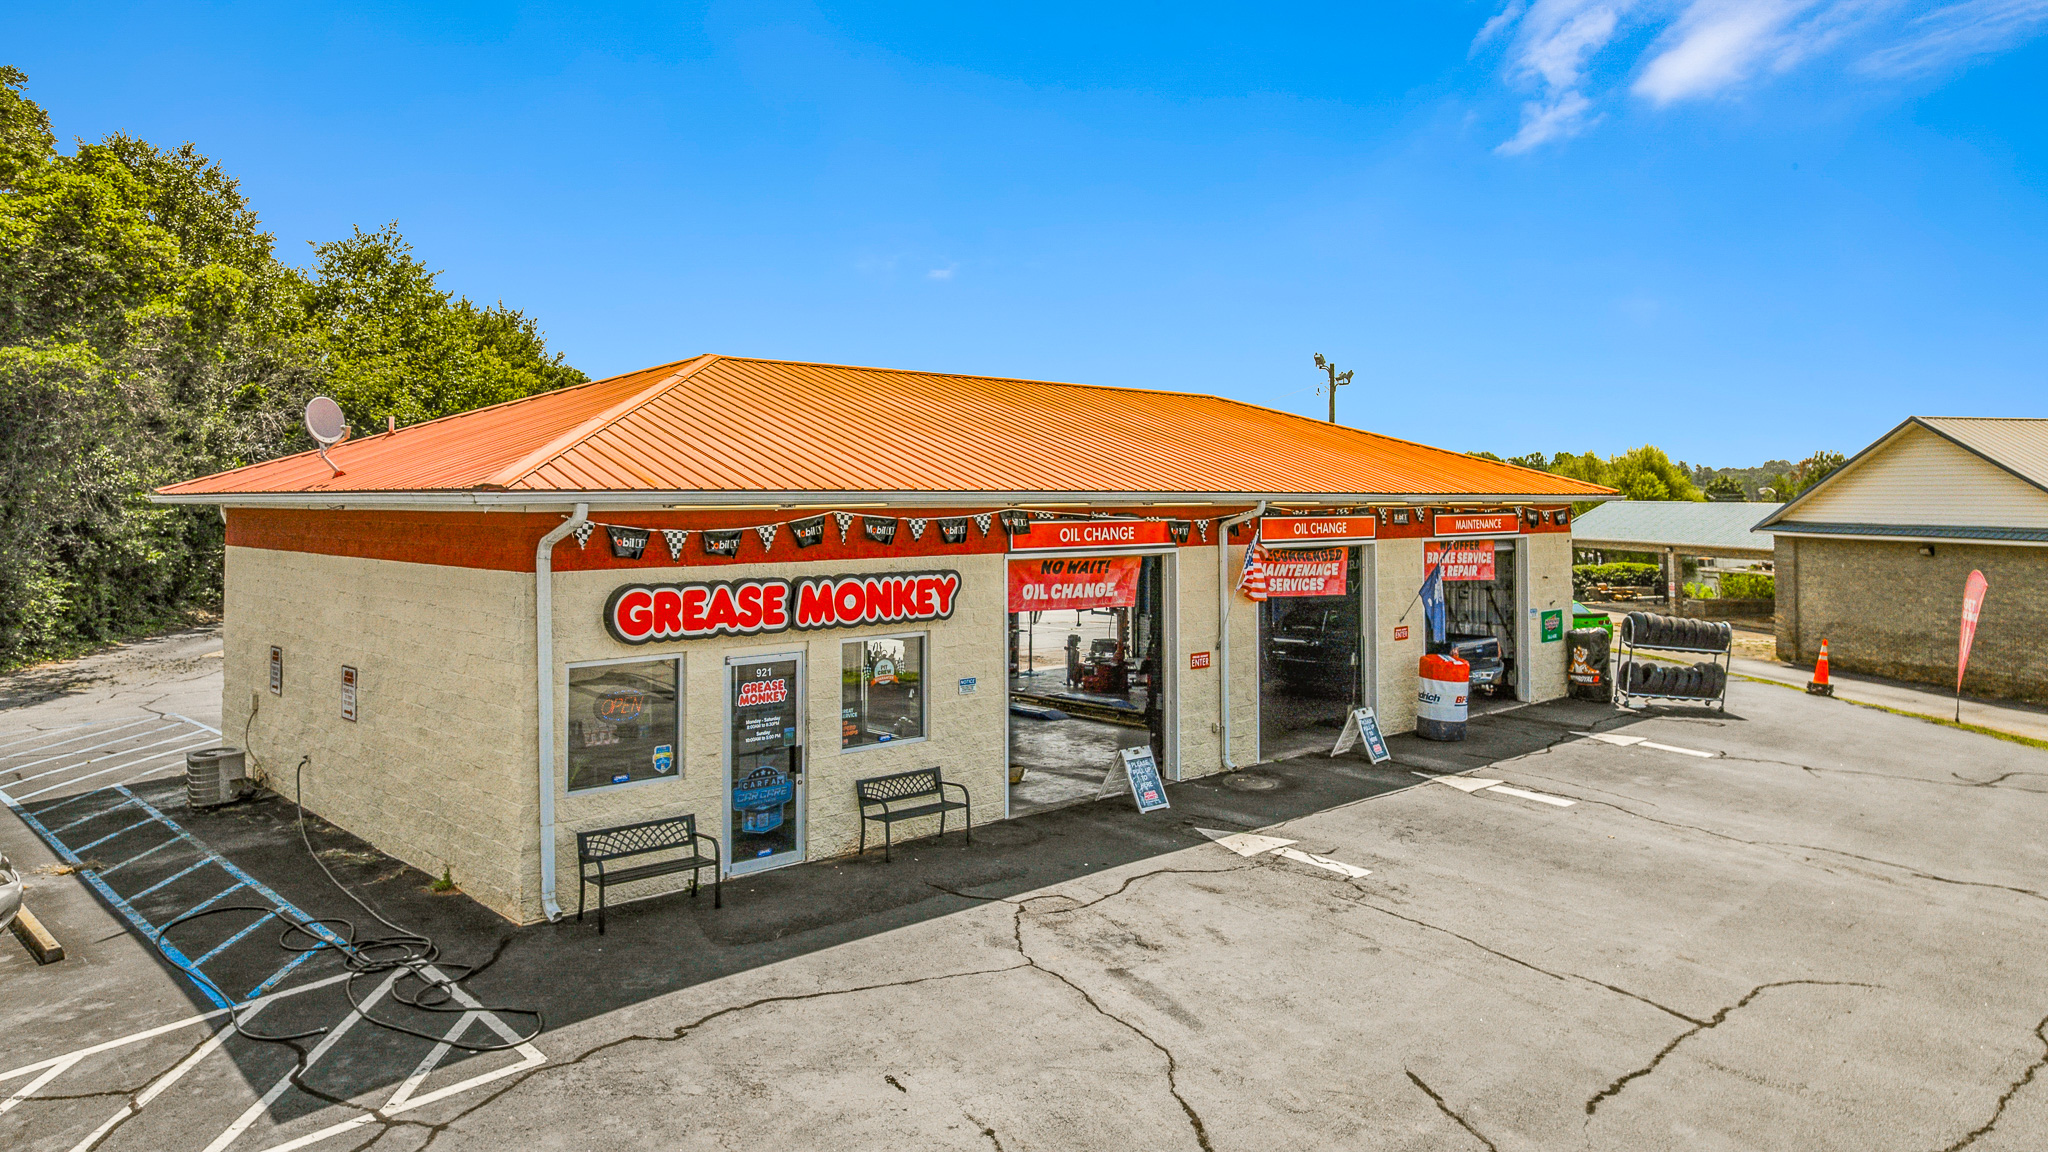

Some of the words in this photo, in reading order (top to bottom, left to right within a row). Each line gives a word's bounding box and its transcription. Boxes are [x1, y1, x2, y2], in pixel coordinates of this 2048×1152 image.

[866, 524, 886, 535] Mobil
[1294, 523, 1308, 534] OIL
[1310, 522, 1347, 534] CHANGE
[1455, 518, 1502, 530] MAINTENANCE
[794, 526, 815, 538] Mobil
[1059, 528, 1080, 542] OIL
[1084, 527, 1134, 541] CHANGE
[1440, 540, 1452, 550] W
[1454, 540, 1479, 550] OFFER
[1265, 549, 1342, 562] ECOMMENDED
[1427, 552, 1456, 564] BRAKE
[1457, 551, 1492, 564] SERVICE
[1041, 560, 1065, 574] NO
[1067, 559, 1112, 574] WAIT!
[1447, 565, 1478, 577] REPAIR
[1022, 583, 1048, 600] OIL
[1051, 582, 1118, 599] CHANGE.
[1268, 577, 1325, 592] SERVICES
[616, 583, 787, 638] GREASE
[797, 575, 957, 627] MONKEY
[1191, 657, 1209, 668] ENTER
[756, 667, 772, 677] 921
[742, 679, 785, 695] GREASE
[739, 690, 787, 706] MONKEY
[601, 695, 644, 715] OPEN
[1130, 760, 1149, 768] PLEASE
[742, 775, 785, 790] CARFAX
[737, 791, 758, 803] CAR
[760, 786, 788, 799] CARE
